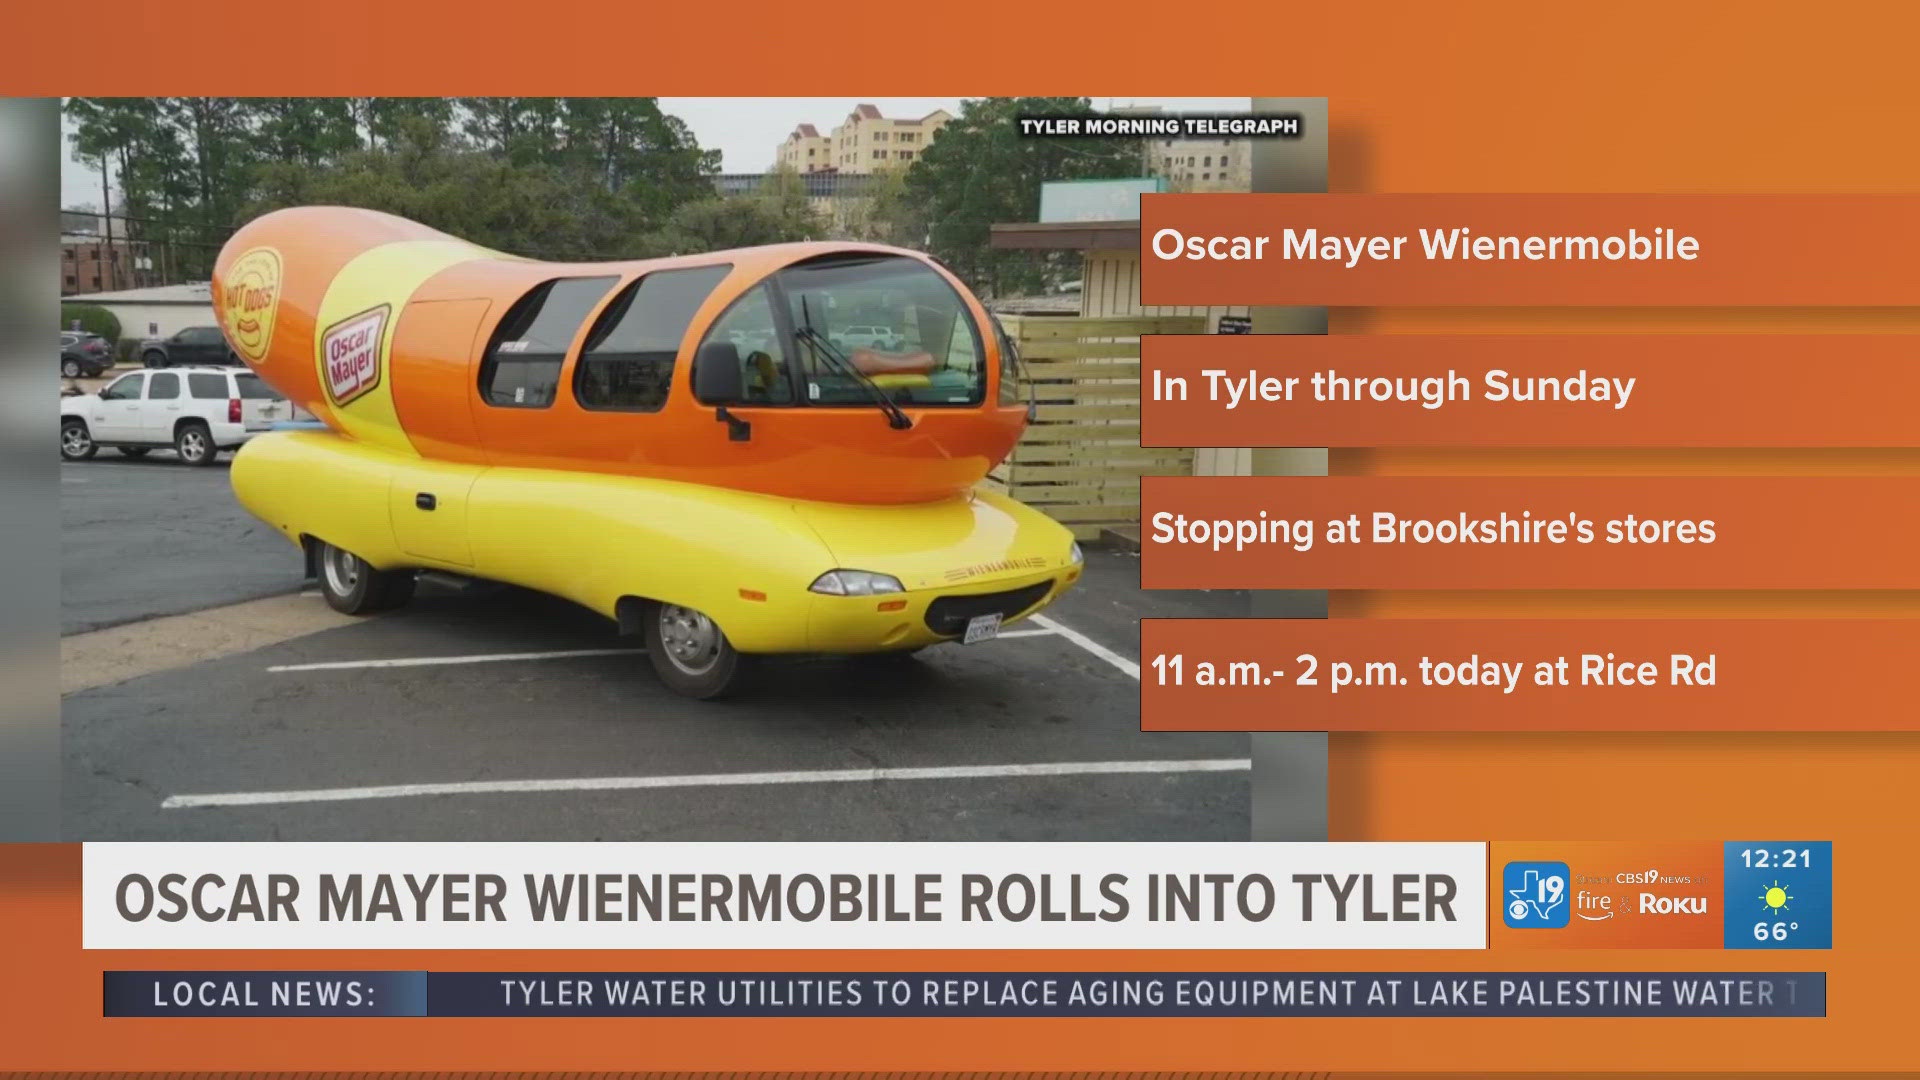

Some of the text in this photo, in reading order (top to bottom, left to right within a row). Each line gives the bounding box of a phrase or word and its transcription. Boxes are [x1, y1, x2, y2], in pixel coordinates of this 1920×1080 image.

[225, 283, 274, 312] HOT DOGS
[331, 326, 374, 361] Oscar
[330, 347, 372, 386] Mayer
